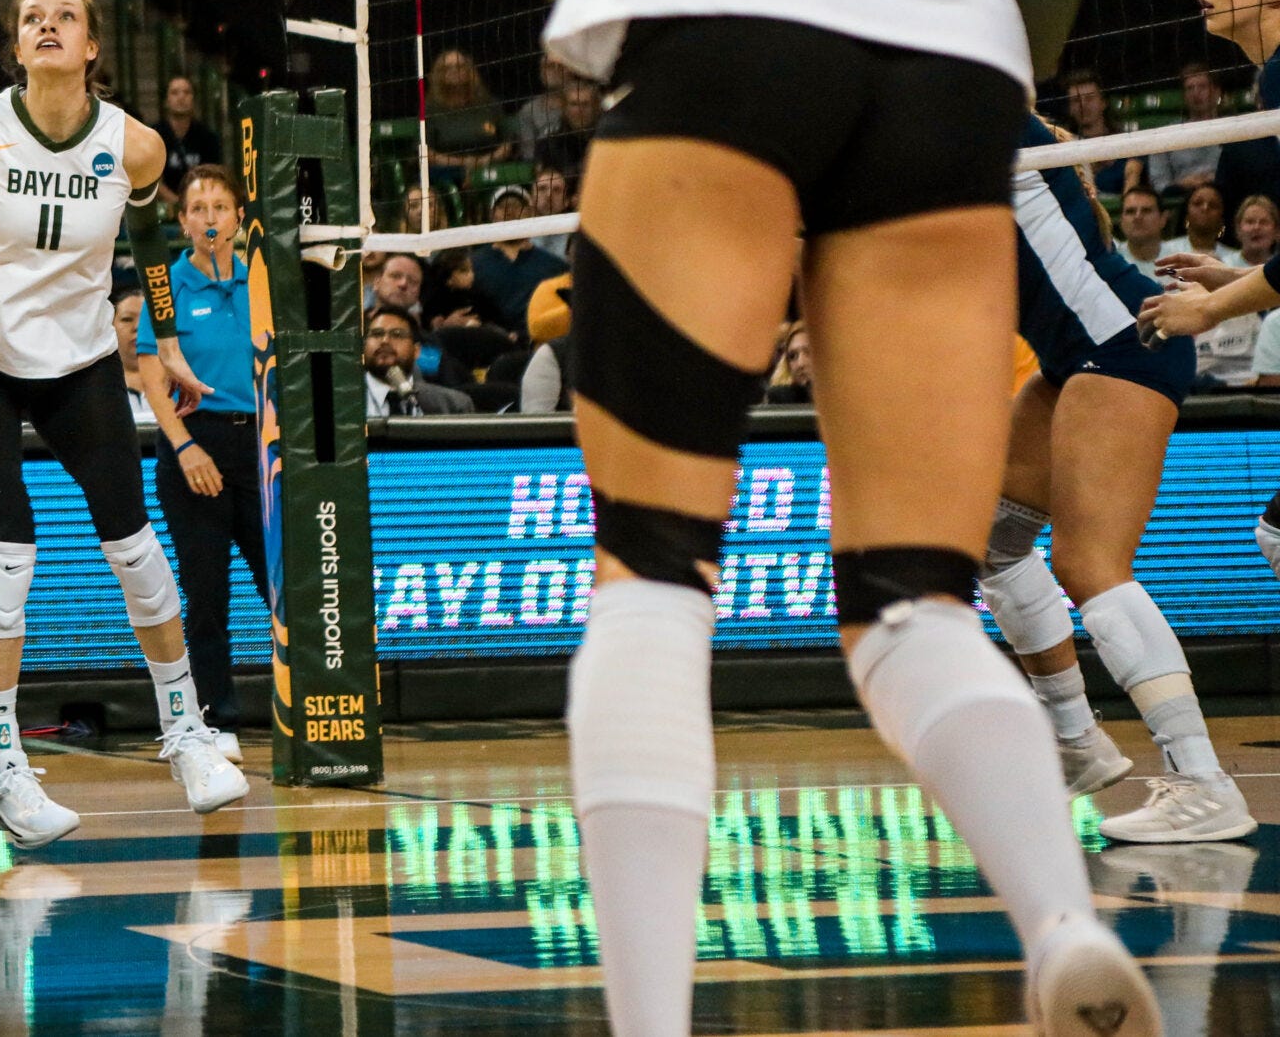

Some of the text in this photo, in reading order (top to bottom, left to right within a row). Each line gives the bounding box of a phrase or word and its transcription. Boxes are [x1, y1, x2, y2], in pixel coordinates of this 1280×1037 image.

[7, 168, 99, 200] BAYLOR
[36, 204, 63, 251] 11
[145, 264, 174, 321] BEARS
[317, 501, 344, 669] sports imports
[304, 694, 365, 716] SIC'EM
[307, 719, 366, 742] BEARS
[311, 765, 332, 775] (800)
